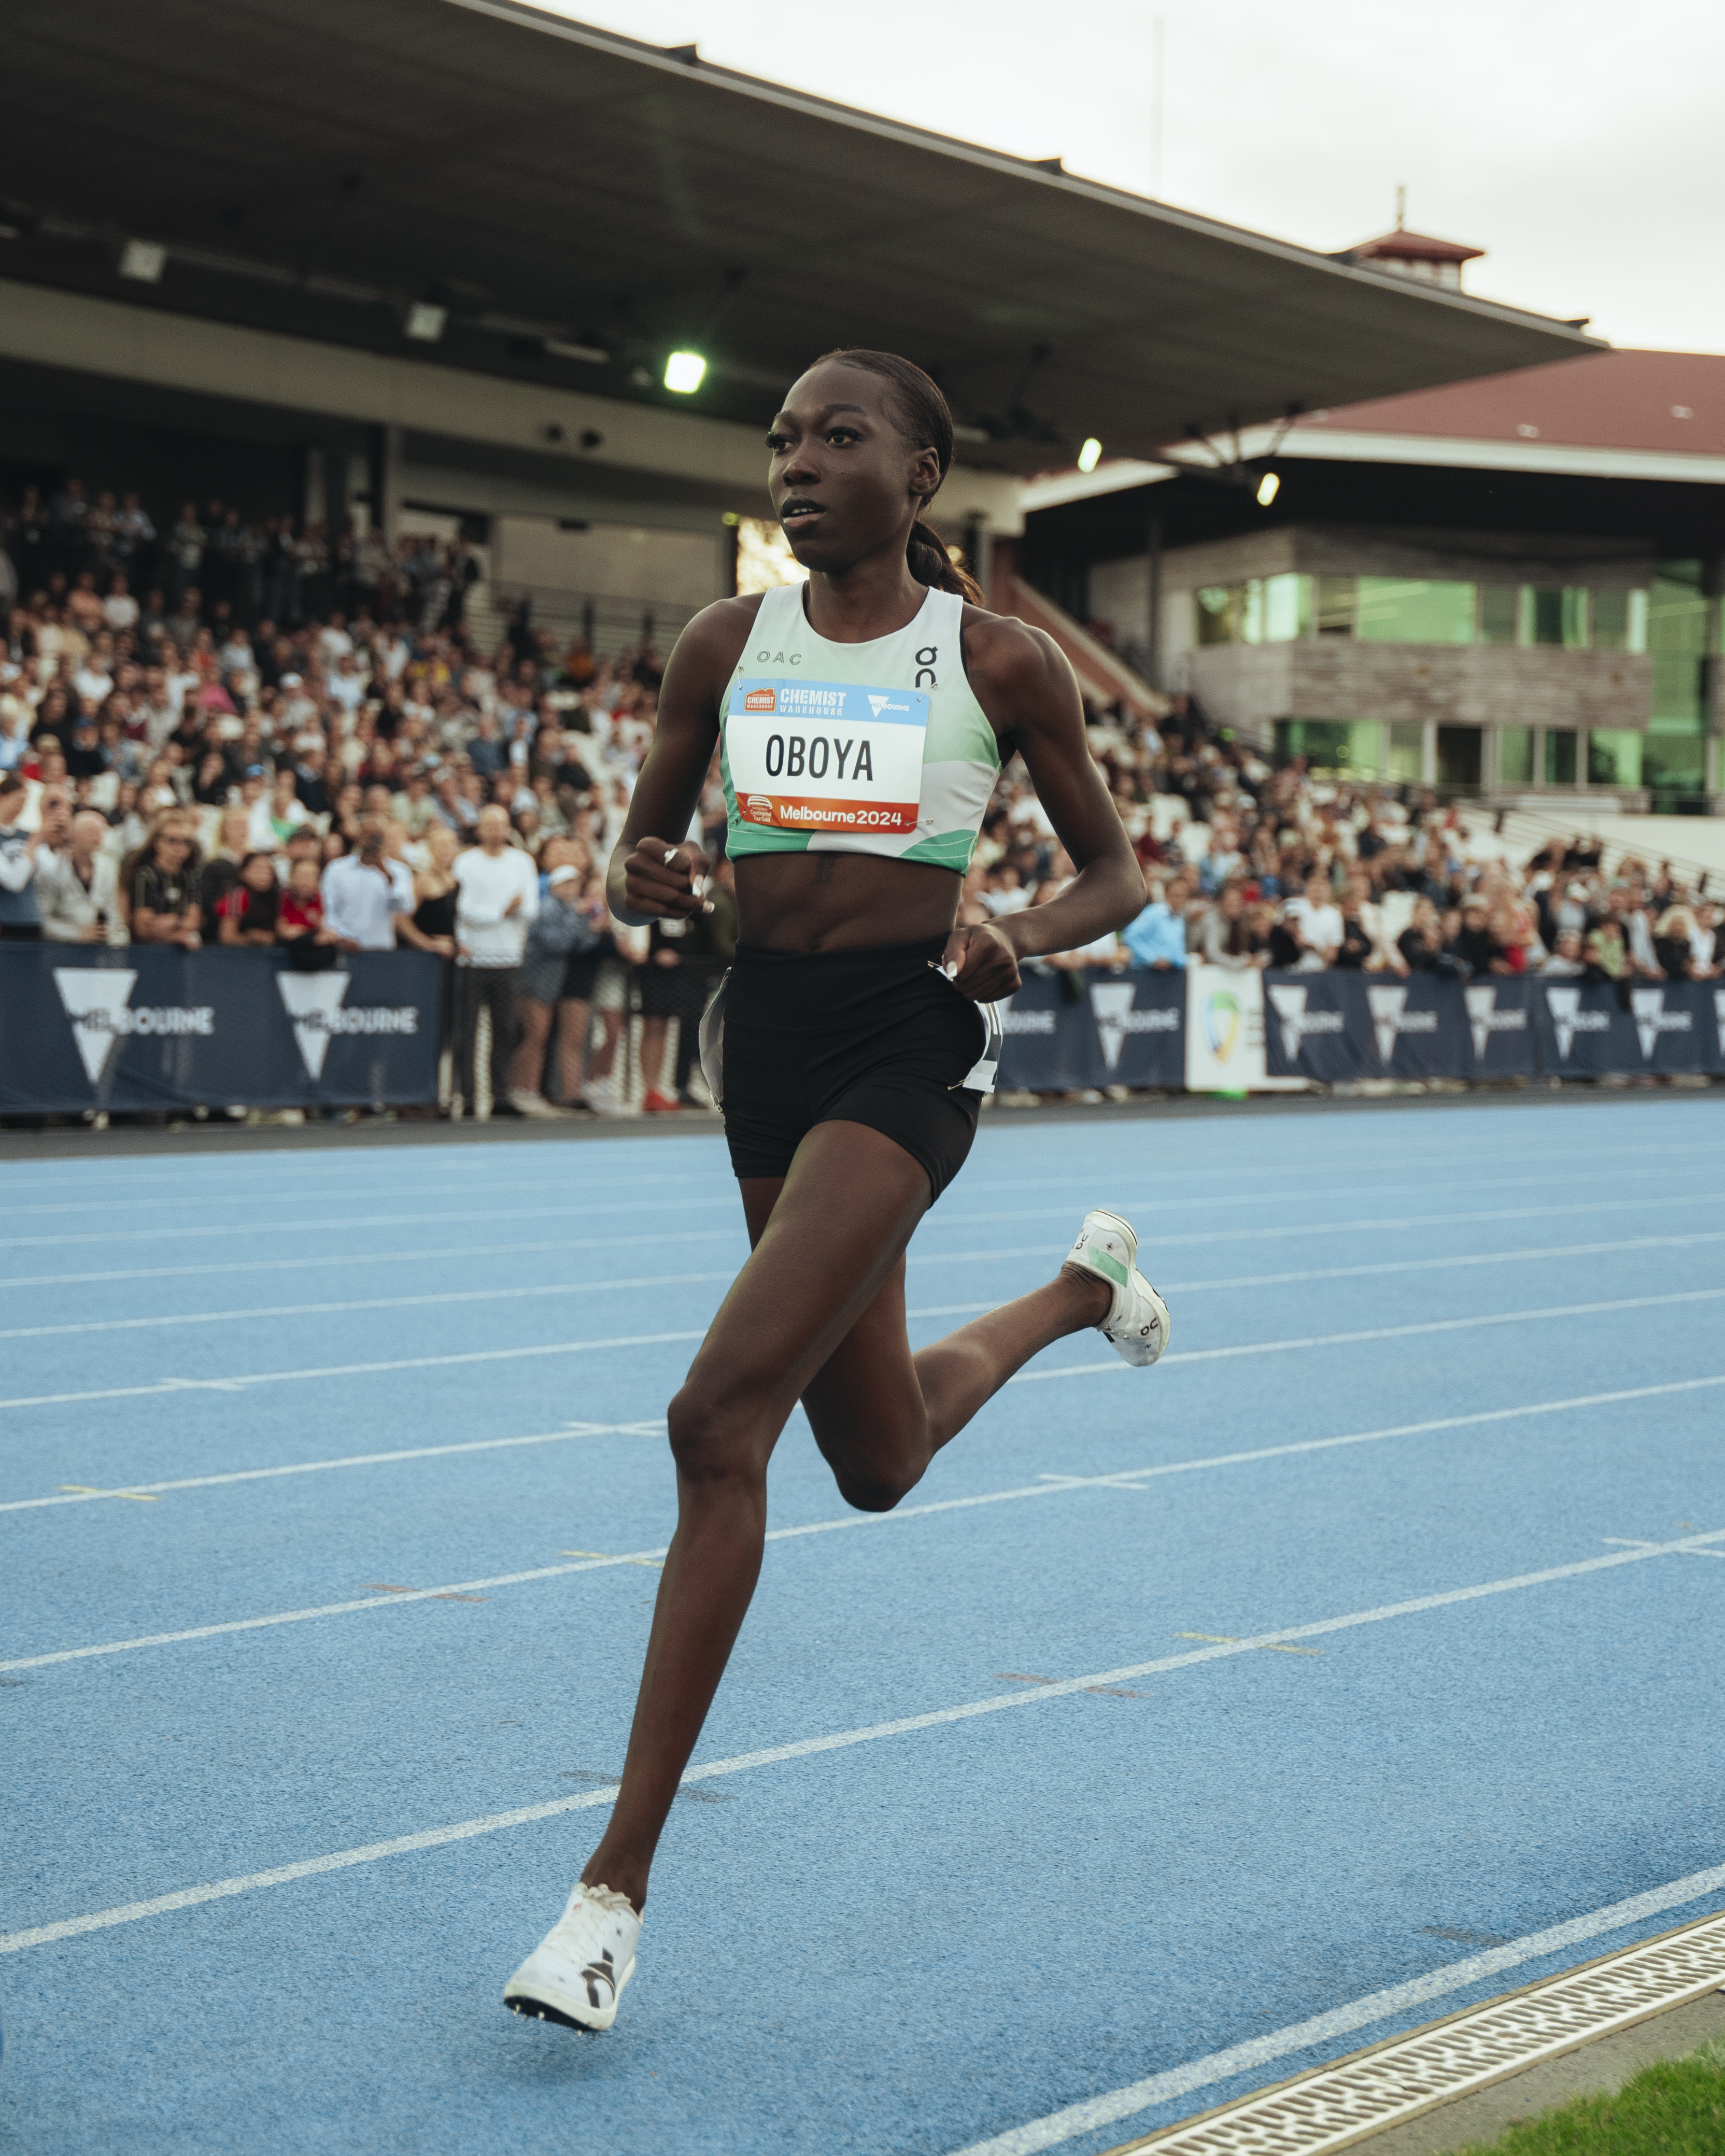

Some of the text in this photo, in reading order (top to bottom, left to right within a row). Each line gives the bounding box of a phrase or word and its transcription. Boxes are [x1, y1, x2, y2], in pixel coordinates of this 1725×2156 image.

[757, 650, 802, 665] OAC
[747, 696, 774, 704] CHEMIST
[780, 688, 847, 707] CHEMIST
[780, 704, 842, 716] WAREHOUSE
[766, 734, 873, 781] OBOYA
[750, 809, 771, 817] Continental
